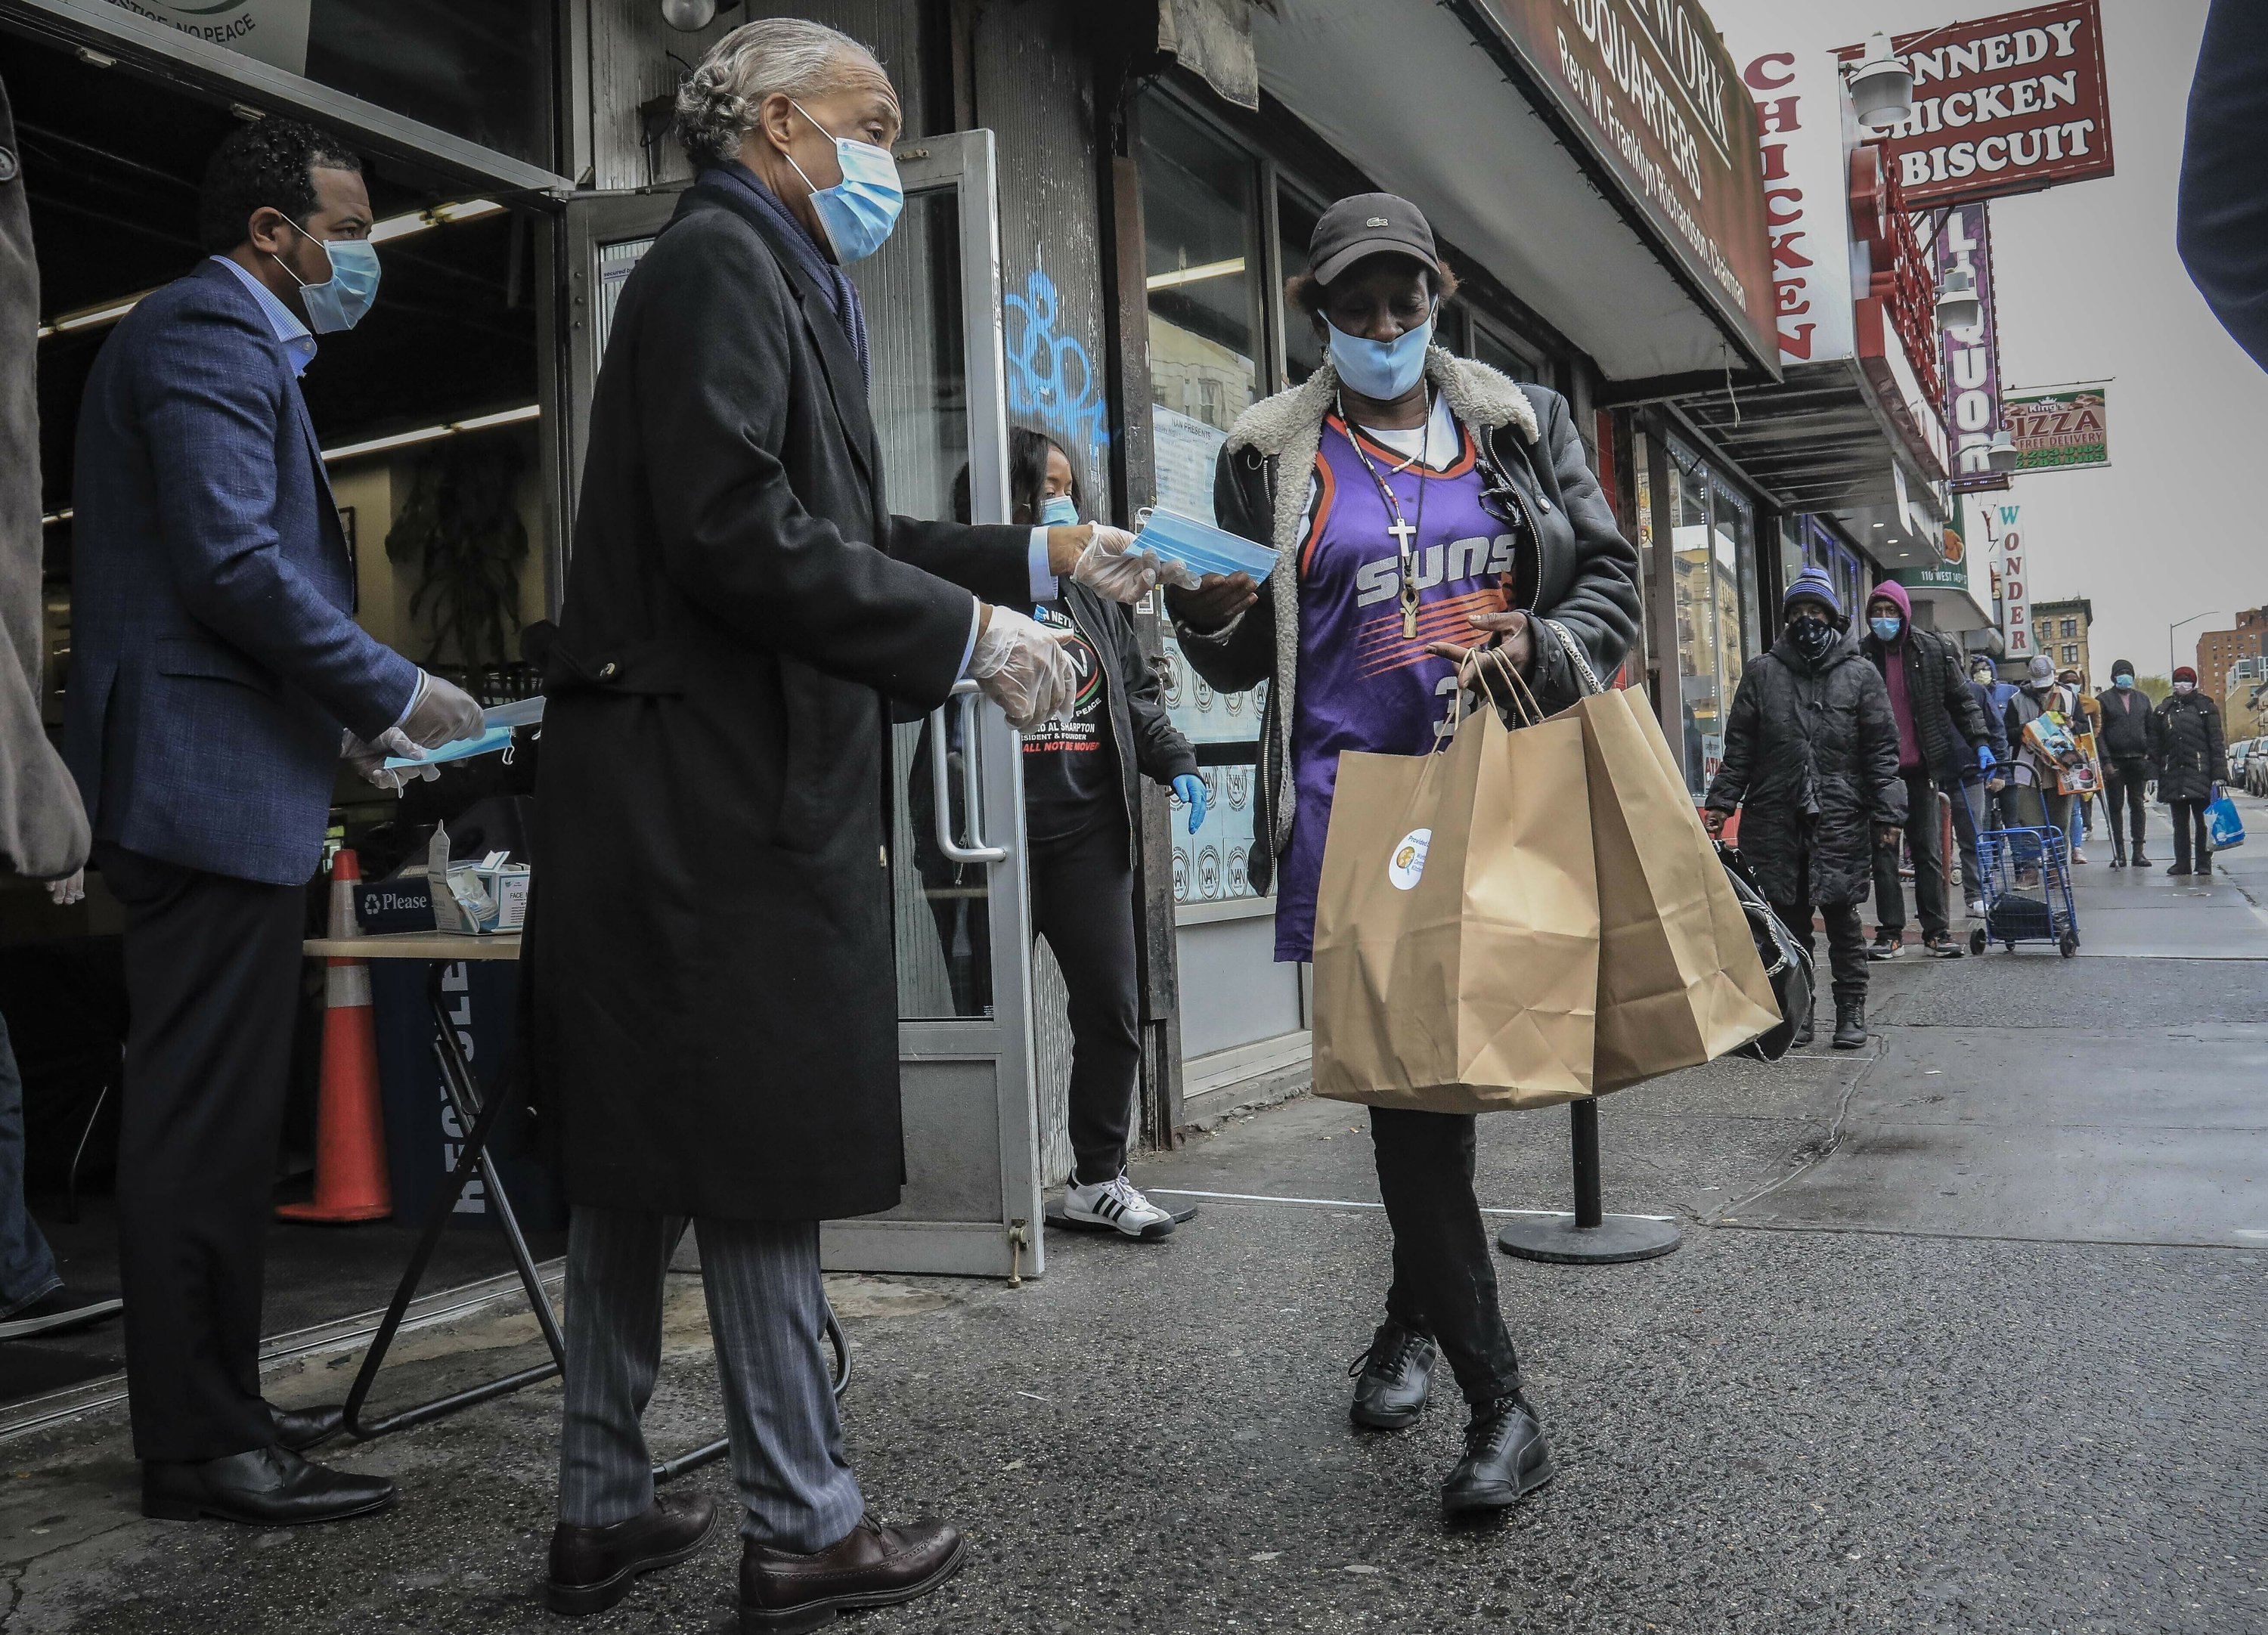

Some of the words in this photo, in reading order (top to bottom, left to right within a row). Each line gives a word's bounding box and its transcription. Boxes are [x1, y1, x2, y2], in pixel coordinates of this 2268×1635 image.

[204, 13, 256, 43] PEACE
[1898, 118, 2095, 187] BISCUIT
[1557, 25, 1588, 107] Rev.
[1606, 94, 1657, 197] Franklyn
[1709, 237, 1746, 312] Chairman
[1743, 52, 1817, 360] CHICKEN
[603, 268, 627, 277] secured
[2028, 401, 2065, 414] King's
[2003, 409, 2103, 440] PIZZA
[2020, 438, 2044, 450] FREE
[2049, 432, 2102, 447] DELIVERY
[1935, 571, 1952, 582] WEST
[2000, 505, 2027, 650] WONDER
[1076, 697, 1102, 717] PEACE
[1048, 722, 1059, 732] AL
[1060, 723, 1095, 733] SHARPTON
[1061, 732, 1087, 741] FOUNDER
[1043, 741, 1065, 751] NOT
[1064, 742, 1073, 751] BE
[1229, 774, 1244, 791] NAN
[1201, 867, 1217, 886] NAN
[1231, 869, 1246, 885] NAN
[381, 893, 428, 911] Please
